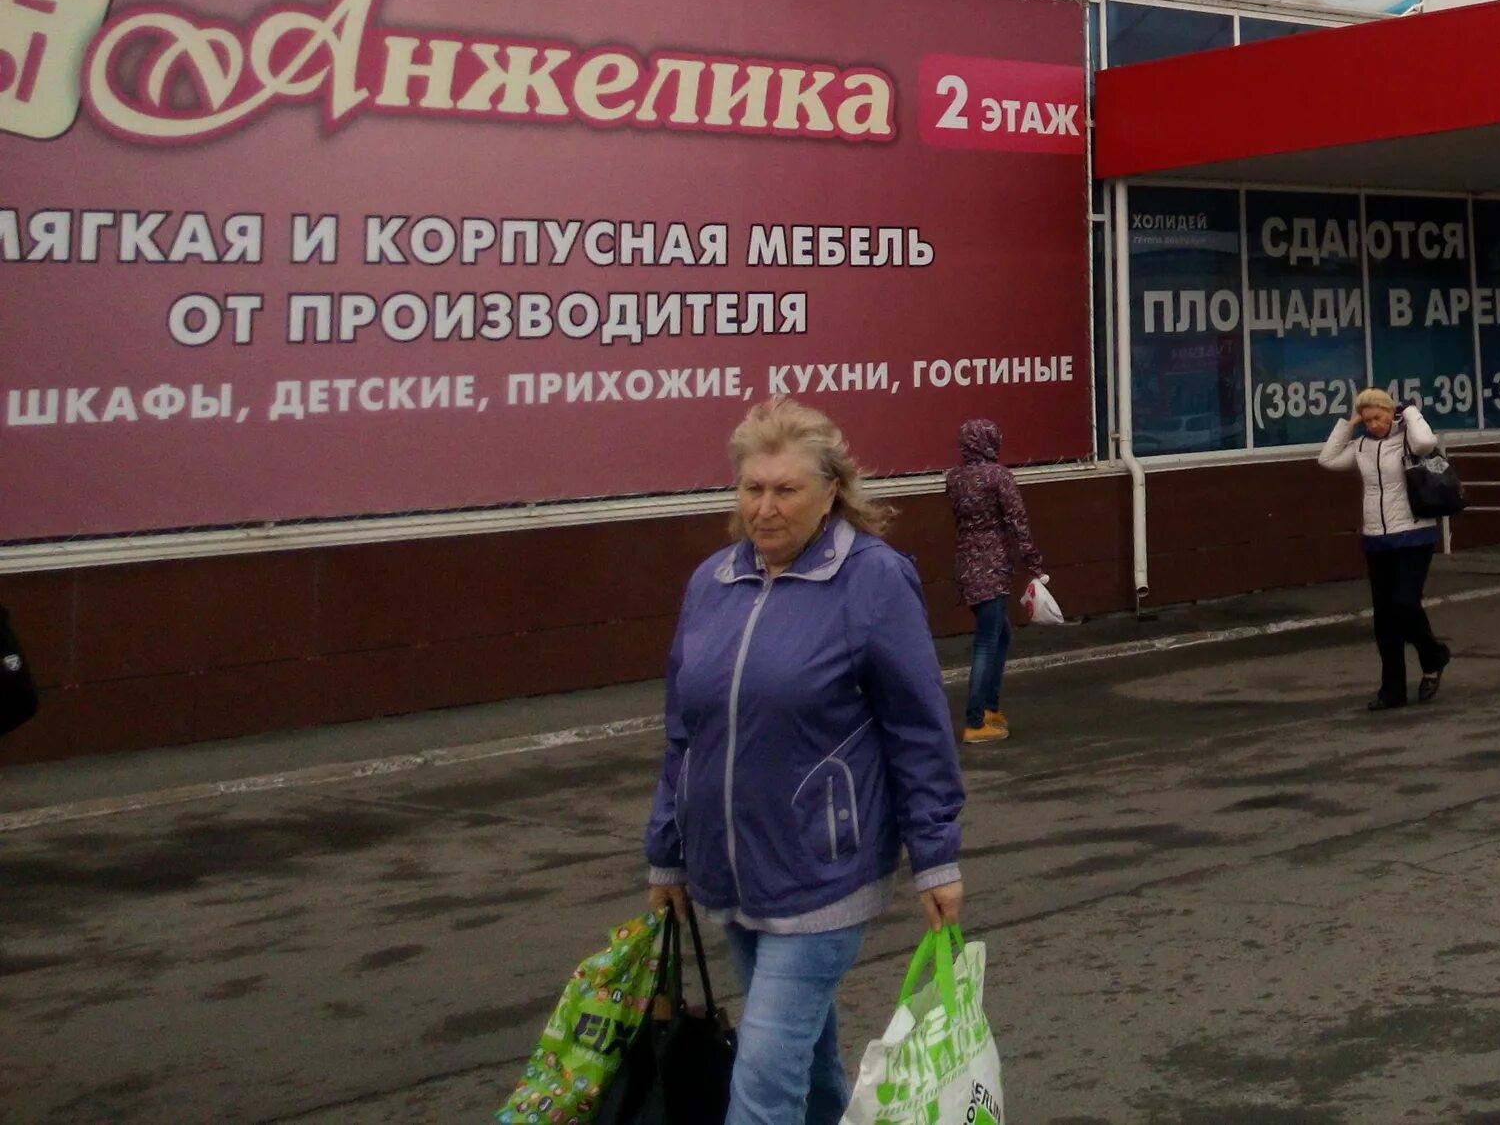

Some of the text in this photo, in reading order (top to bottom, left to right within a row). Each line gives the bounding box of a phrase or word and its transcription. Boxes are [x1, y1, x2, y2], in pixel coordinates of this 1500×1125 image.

[935, 75, 1080, 136] 2 ЭТАЖ
[290, 214, 338, 265] И
[365, 216, 729, 266] КОРПУСНАЯ
[747, 224, 936, 267] МЕБЕЛЬ
[1132, 213, 1208, 231] ХОЛИДЕЙ
[1261, 216, 1465, 266] СДАЮТСЯ
[168, 291, 809, 346] ОТ ПРОИЗВОДИТЕЛЯ
[1144, 288, 1363, 337] ПЛОЩАДИ
[1389, 288, 1413, 327] В
[6, 355, 1074, 426] ШКАФЫ, ДЕТСКИЕ, ПРИХОЖИЕ, КУХНИ, ГОСТИНЫЕ
